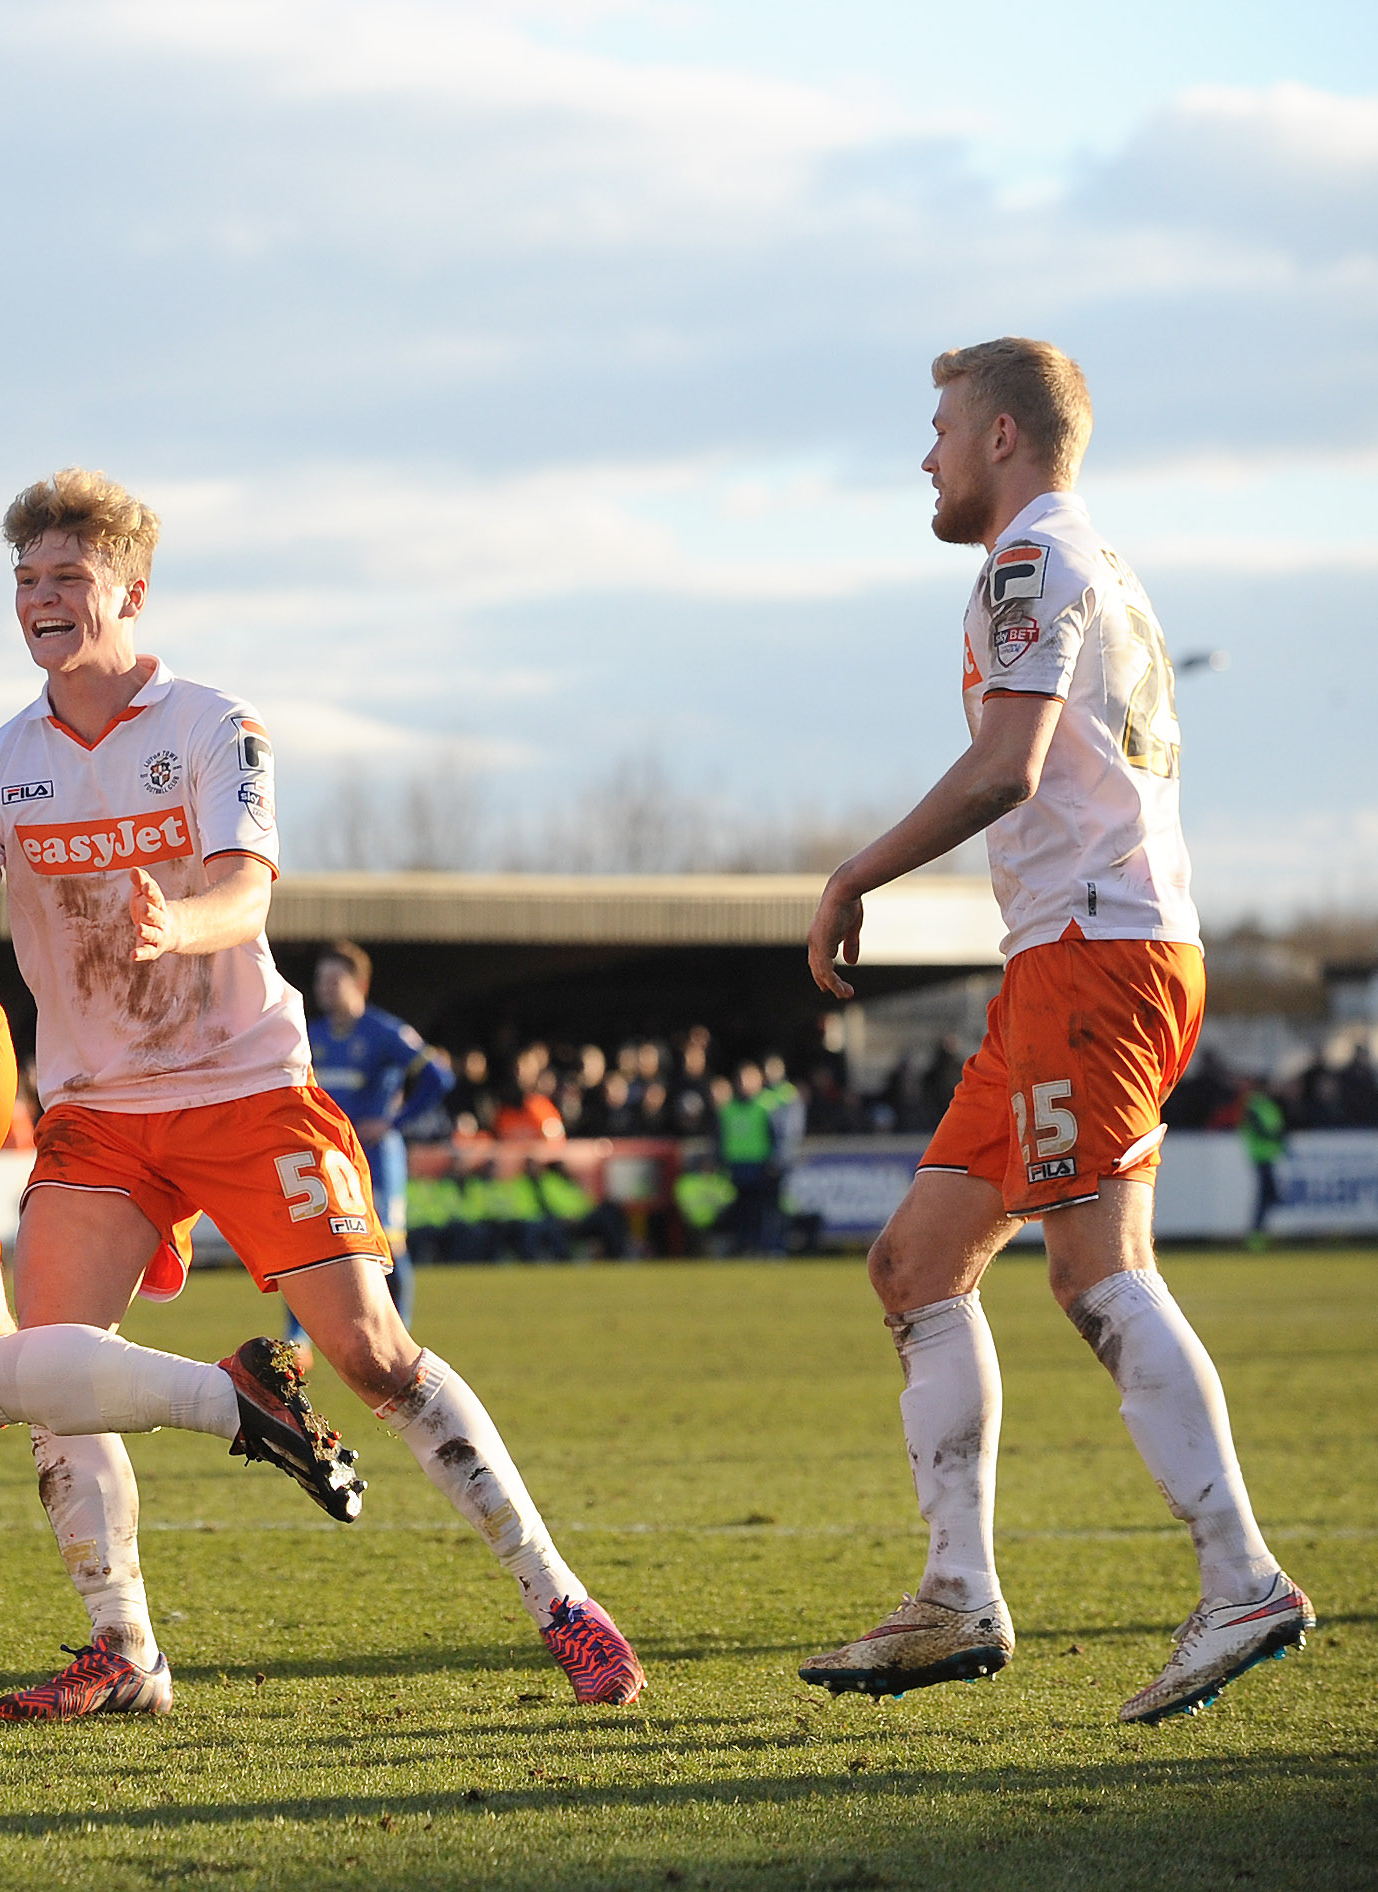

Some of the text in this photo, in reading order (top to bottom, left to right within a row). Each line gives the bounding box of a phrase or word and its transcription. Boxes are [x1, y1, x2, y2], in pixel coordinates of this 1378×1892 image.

[1009, 628, 1037, 641] BET
[7, 784, 49, 801] FILA
[22, 816, 187, 868] easyJet
[1031, 1162, 1071, 1181] FILA
[274, 1150, 367, 1224] 50
[333, 1219, 365, 1232] FILA
